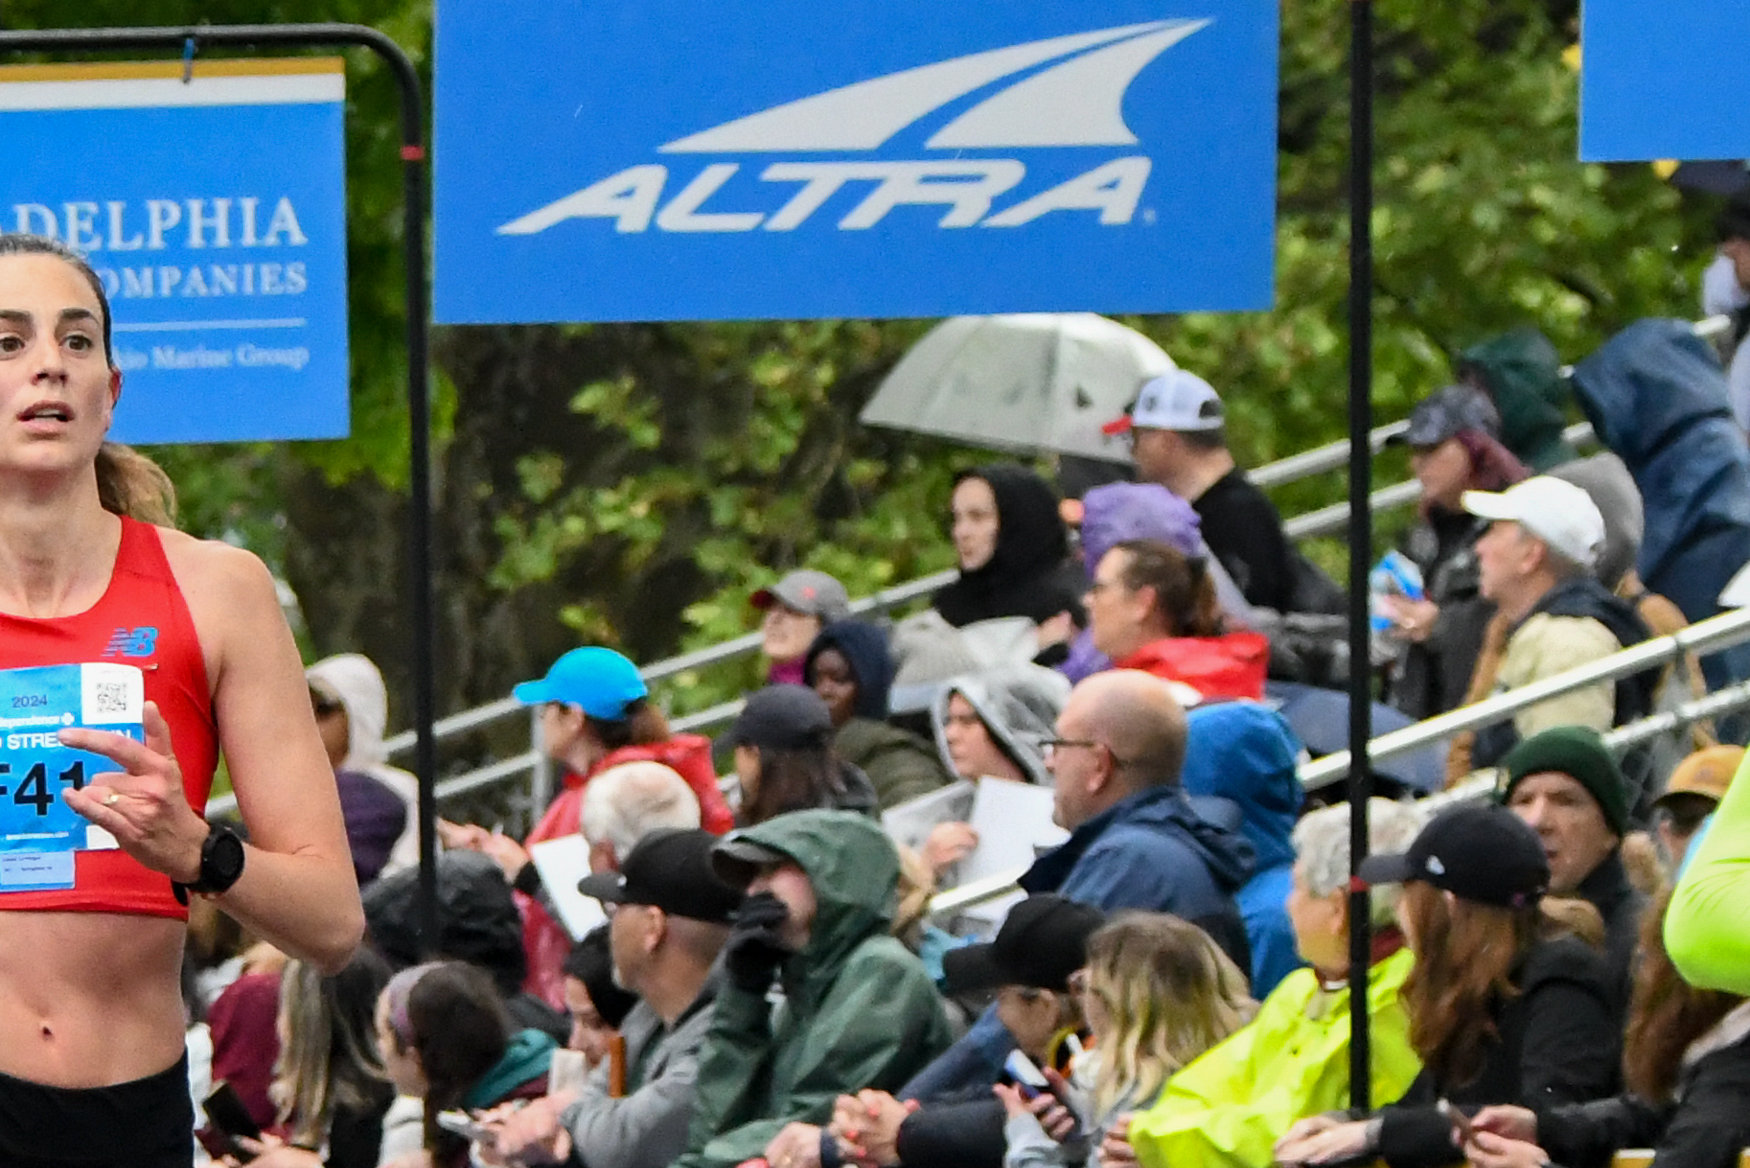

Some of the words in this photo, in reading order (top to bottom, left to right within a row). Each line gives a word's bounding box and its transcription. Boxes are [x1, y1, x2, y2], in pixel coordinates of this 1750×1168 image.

[496, 155, 1153, 236] ALTRA
[96, 261, 307, 300] OMPANIES
[12, 695, 48, 709] 2024
[7, 732, 64, 750] STRE
